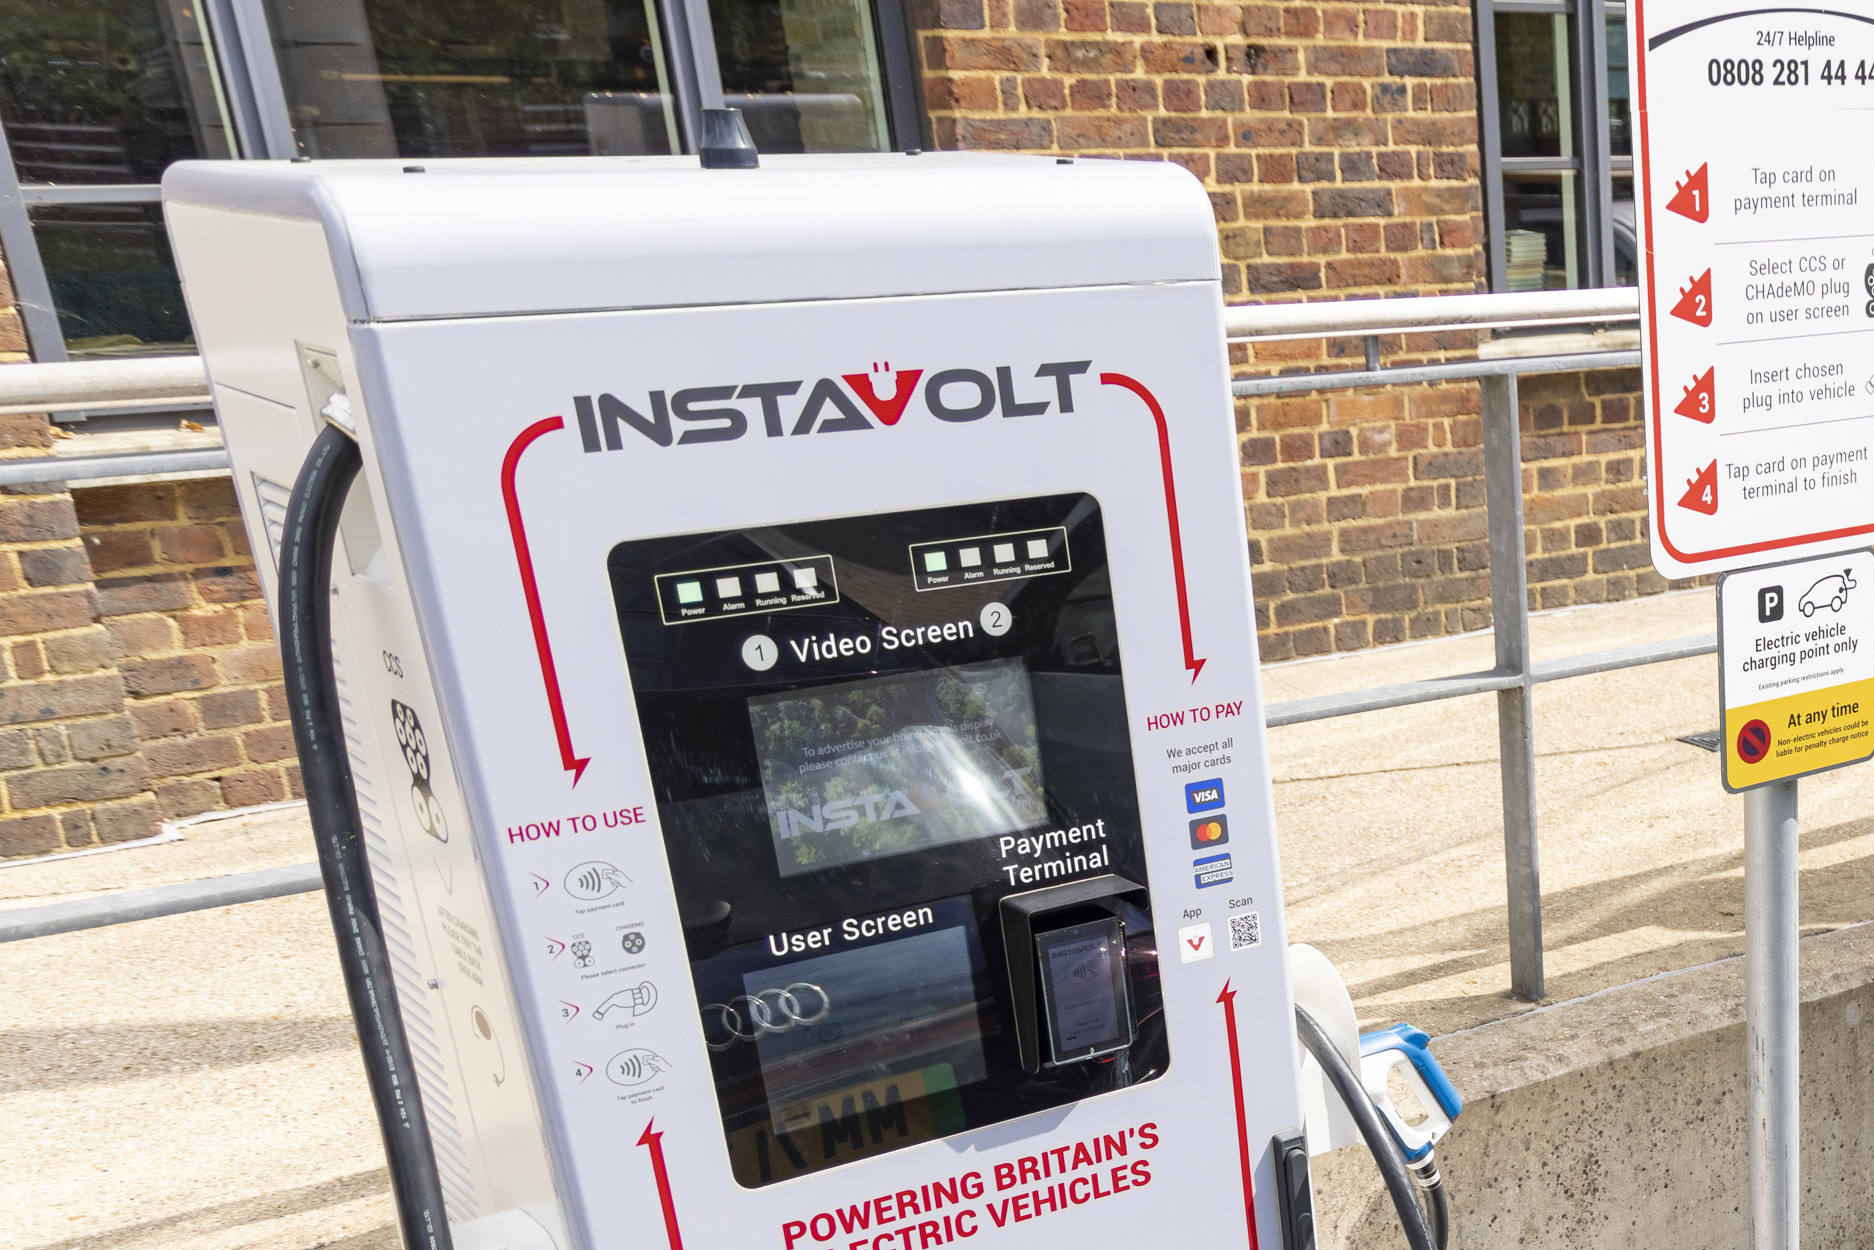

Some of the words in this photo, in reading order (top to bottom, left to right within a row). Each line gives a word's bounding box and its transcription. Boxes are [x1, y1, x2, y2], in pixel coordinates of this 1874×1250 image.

[1756, 30, 1784, 47] 24/7
[1788, 30, 1835, 50] Helpline
[1707, 58, 1764, 86] 0808
[1772, 58, 1808, 86] 281
[1820, 59, 1846, 85] 44
[1751, 167, 1776, 188] Tap
[1782, 165, 1812, 183] card
[1818, 169, 1835, 182] on
[1734, 192, 1795, 215] payment
[1801, 187, 1857, 207] terminal
[1749, 257, 1792, 276] Select
[1798, 255, 1826, 272] CCS
[1832, 257, 1846, 270] or
[1745, 279, 1815, 301] CHAdeMO
[1821, 278, 1849, 299] plug
[1695, 295, 1706, 316] 2
[1746, 311, 1763, 324] on
[1769, 308, 1799, 323] user
[1804, 304, 1849, 320] screen
[1750, 366, 1789, 384] Insert
[1795, 362, 1843, 380] chosen
[573, 360, 1091, 453] INSTAVOLT
[1699, 392, 1710, 413] 3
[1742, 391, 1772, 413] plug
[1778, 388, 1803, 404] into
[1808, 380, 1855, 400] vehicle
[1725, 463, 1749, 481] Tap
[1755, 455, 1784, 475] card
[1790, 456, 1806, 470] on
[1812, 446, 1867, 474] payment
[1702, 486, 1712, 504] 4
[1742, 476, 1797, 500] terminal
[1803, 476, 1816, 490] to
[1821, 468, 1857, 488] finish
[928, 575, 949, 584] Power
[964, 570, 984, 579] Alarm
[993, 565, 1020, 576] Running
[1024, 560, 1055, 572] Reserved
[682, 607, 705, 616] Power
[723, 601, 745, 611] Alarm
[756, 596, 786, 607] Running
[791, 591, 825, 603] Reserved
[790, 634, 871, 662] Video
[882, 619, 974, 650] Screen
[1755, 630, 1800, 652] Electric
[1804, 622, 1846, 642] vehicle
[383, 650, 403, 679] CCS
[1742, 650, 1796, 672] charging
[1799, 642, 1830, 664] point
[1833, 636, 1858, 653] only
[1758, 681, 1779, 690] Existing
[1780, 677, 1800, 687] parking
[1800, 670, 1829, 681] restrictions
[1829, 666, 1844, 676] apply
[1147, 710, 1184, 730] HOW
[1189, 706, 1210, 723] TO
[1215, 701, 1242, 717] PAY
[1787, 712, 1801, 728] At
[1805, 709, 1828, 724] any
[1830, 702, 1859, 718] time
[802, 747, 815, 757] To
[818, 739, 864, 756] advertise
[867, 736, 889, 750] your
[893, 730, 922, 743] brand
[961, 717, 994, 733] display
[1775, 747, 1793, 757] liable
[1793, 744, 1804, 754] for
[1804, 739, 1827, 752] penalty
[1828, 735, 1849, 745] charge
[1850, 730, 1868, 740] notice
[1777, 732, 1817, 746] Non-electric
[1817, 726, 1842, 737] vehicles
[1843, 720, 1860, 731] could
[1860, 718, 1869, 727] be
[1166, 748, 1182, 759] We
[1186, 743, 1219, 756] accept
[1222, 738, 1234, 748] all
[799, 760, 832, 775] please
[835, 752, 875, 767] contact
[876, 750, 888, 760] us
[1172, 761, 1200, 774] major
[1204, 754, 1232, 767] cards
[1194, 790, 1218, 802] VISA
[508, 821, 561, 844] HOW
[566, 814, 597, 834] TO
[603, 806, 646, 828] USE
[1000, 819, 1106, 860] Payment
[1002, 845, 1109, 886] Terminal
[1194, 860, 1229, 873] AMERICAN
[1202, 870, 1233, 882] EXPRESS
[1183, 907, 1202, 919] App
[1229, 897, 1253, 909] Scan
[769, 925, 833, 957] User
[842, 905, 934, 942] Screen
[782, 1171, 985, 1250] POWERING
[994, 1122, 1159, 1192] BRITAIN'S
[986, 1159, 1151, 1227] VEHICLES
